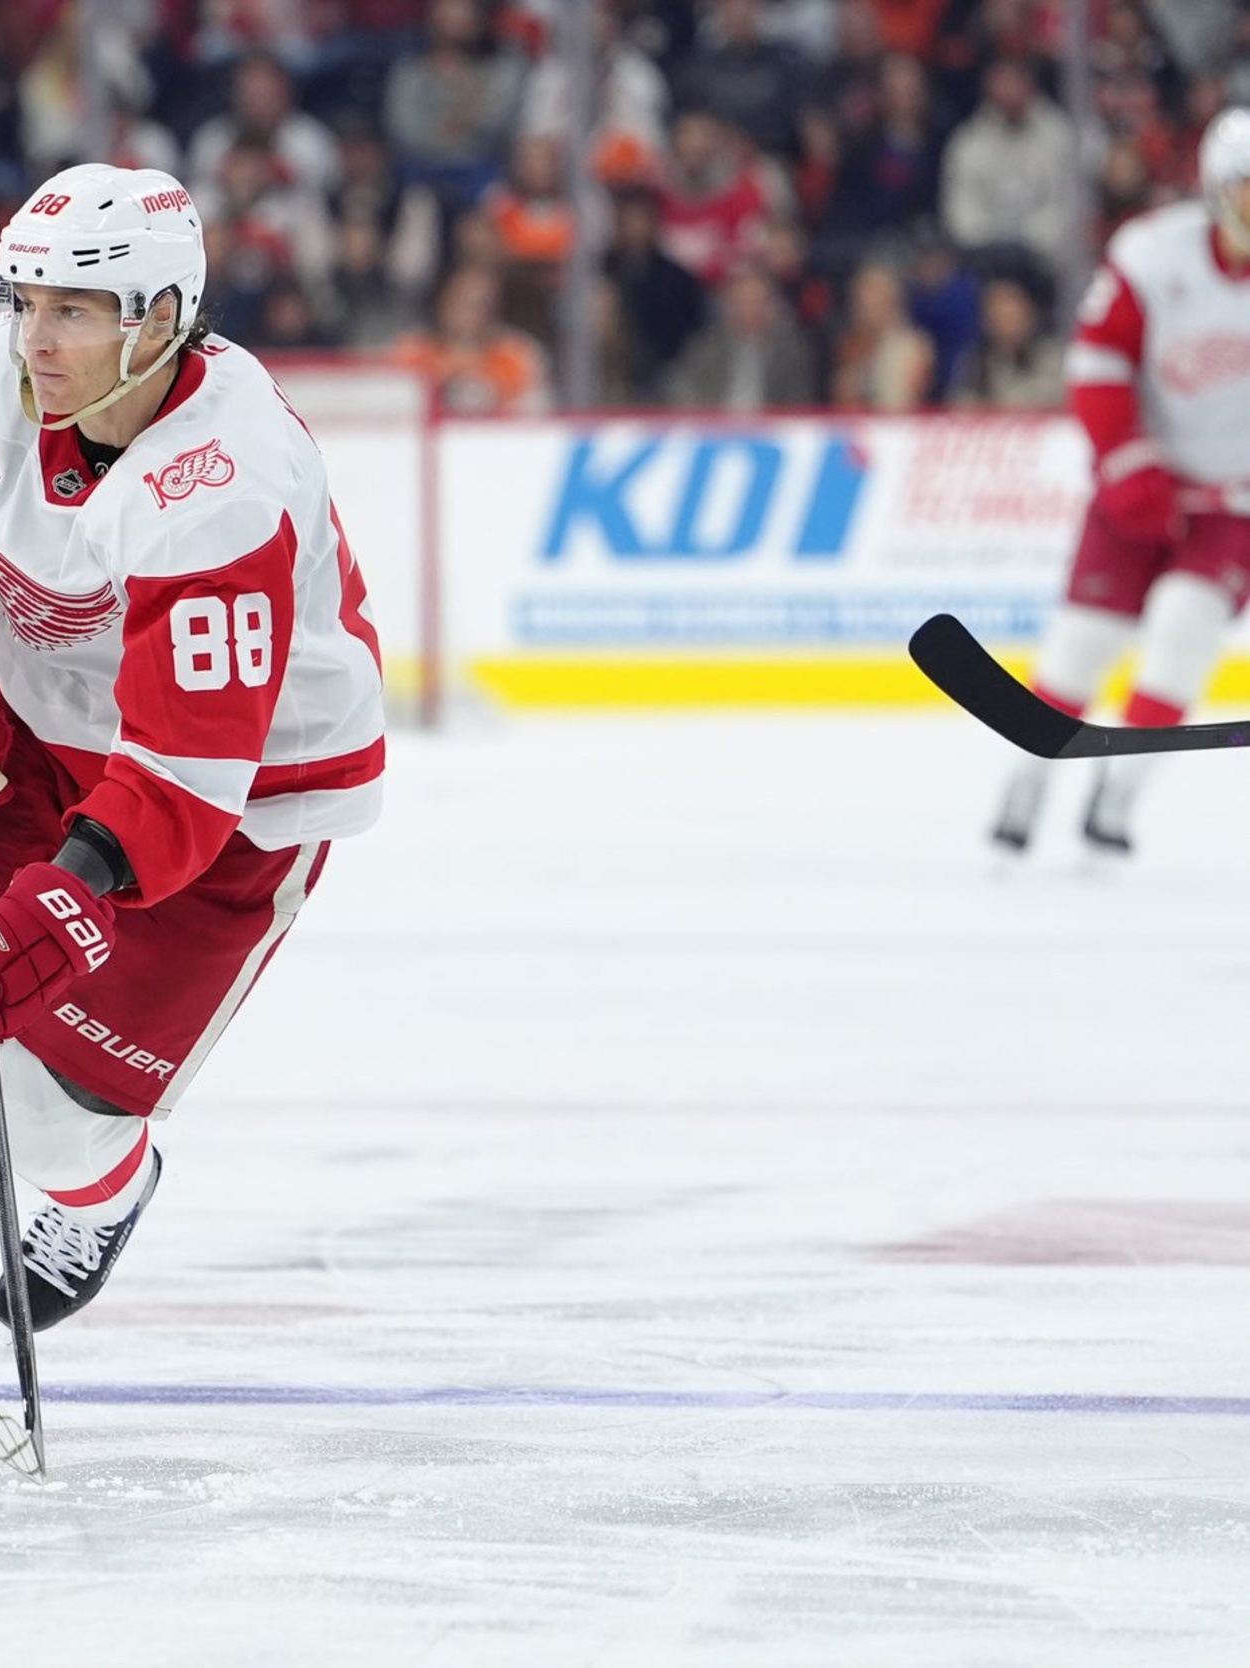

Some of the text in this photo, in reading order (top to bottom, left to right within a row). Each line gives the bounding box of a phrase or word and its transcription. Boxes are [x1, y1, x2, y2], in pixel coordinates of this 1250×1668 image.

[30, 193, 71, 216] 88
[141, 189, 191, 213] meijer
[8, 243, 50, 255] BAUER
[540, 437, 868, 561] KDI
[170, 591, 273, 692] 88
[36, 888, 111, 973] BAU
[53, 1003, 176, 1081] BAUER
